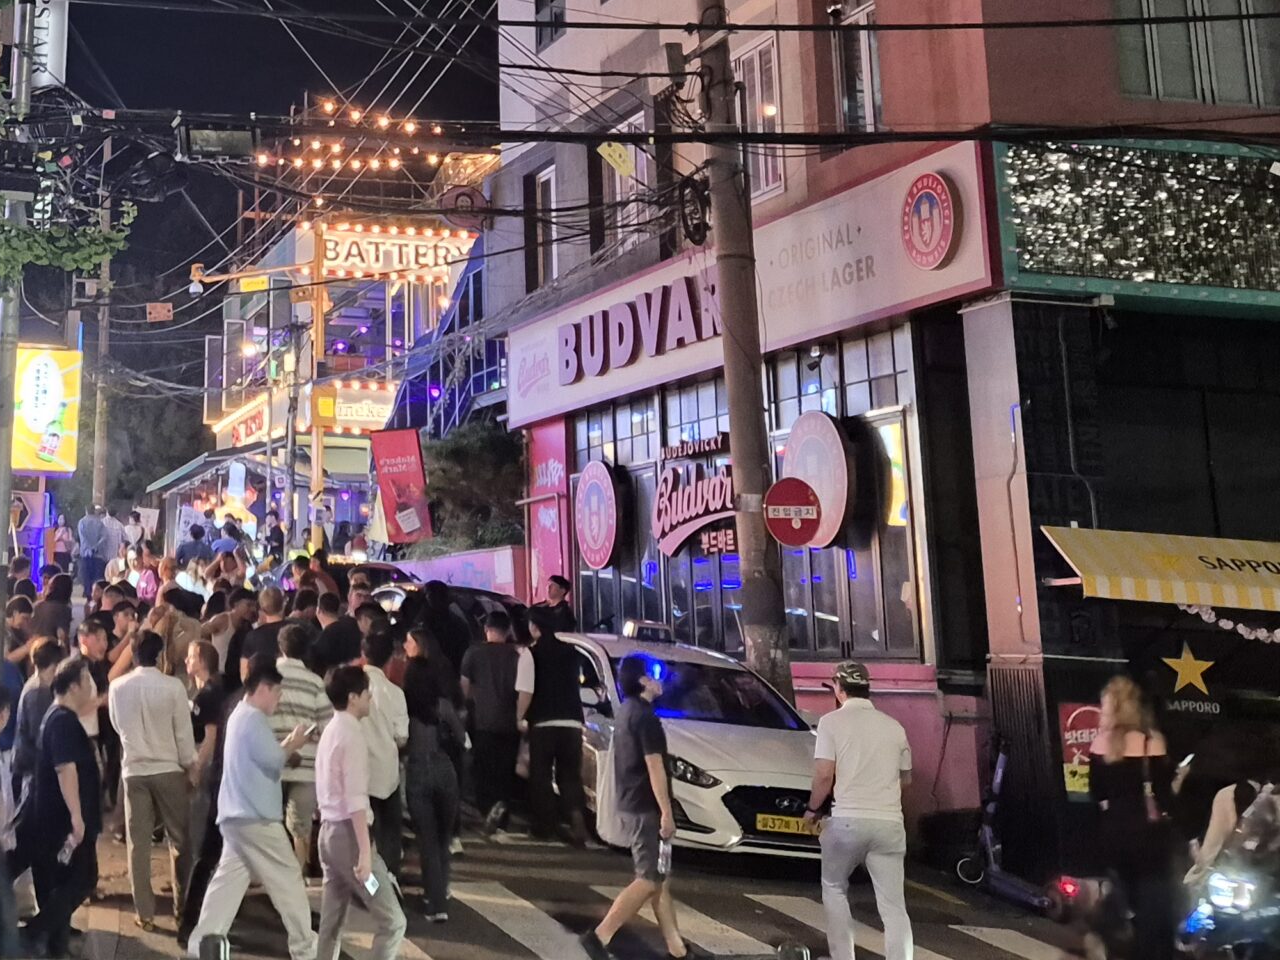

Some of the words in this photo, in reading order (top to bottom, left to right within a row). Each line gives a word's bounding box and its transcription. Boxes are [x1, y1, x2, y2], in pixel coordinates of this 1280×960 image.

[778, 222, 854, 270] ORIGINAL
[822, 254, 877, 294] LAGER
[558, 262, 723, 387] BUDVAR
[652, 462, 734, 540] Budvar
[770, 507, 815, 518] 진입금지
[701, 528, 735, 555] 부드바르
[1167, 700, 1221, 714] SAPPORO
